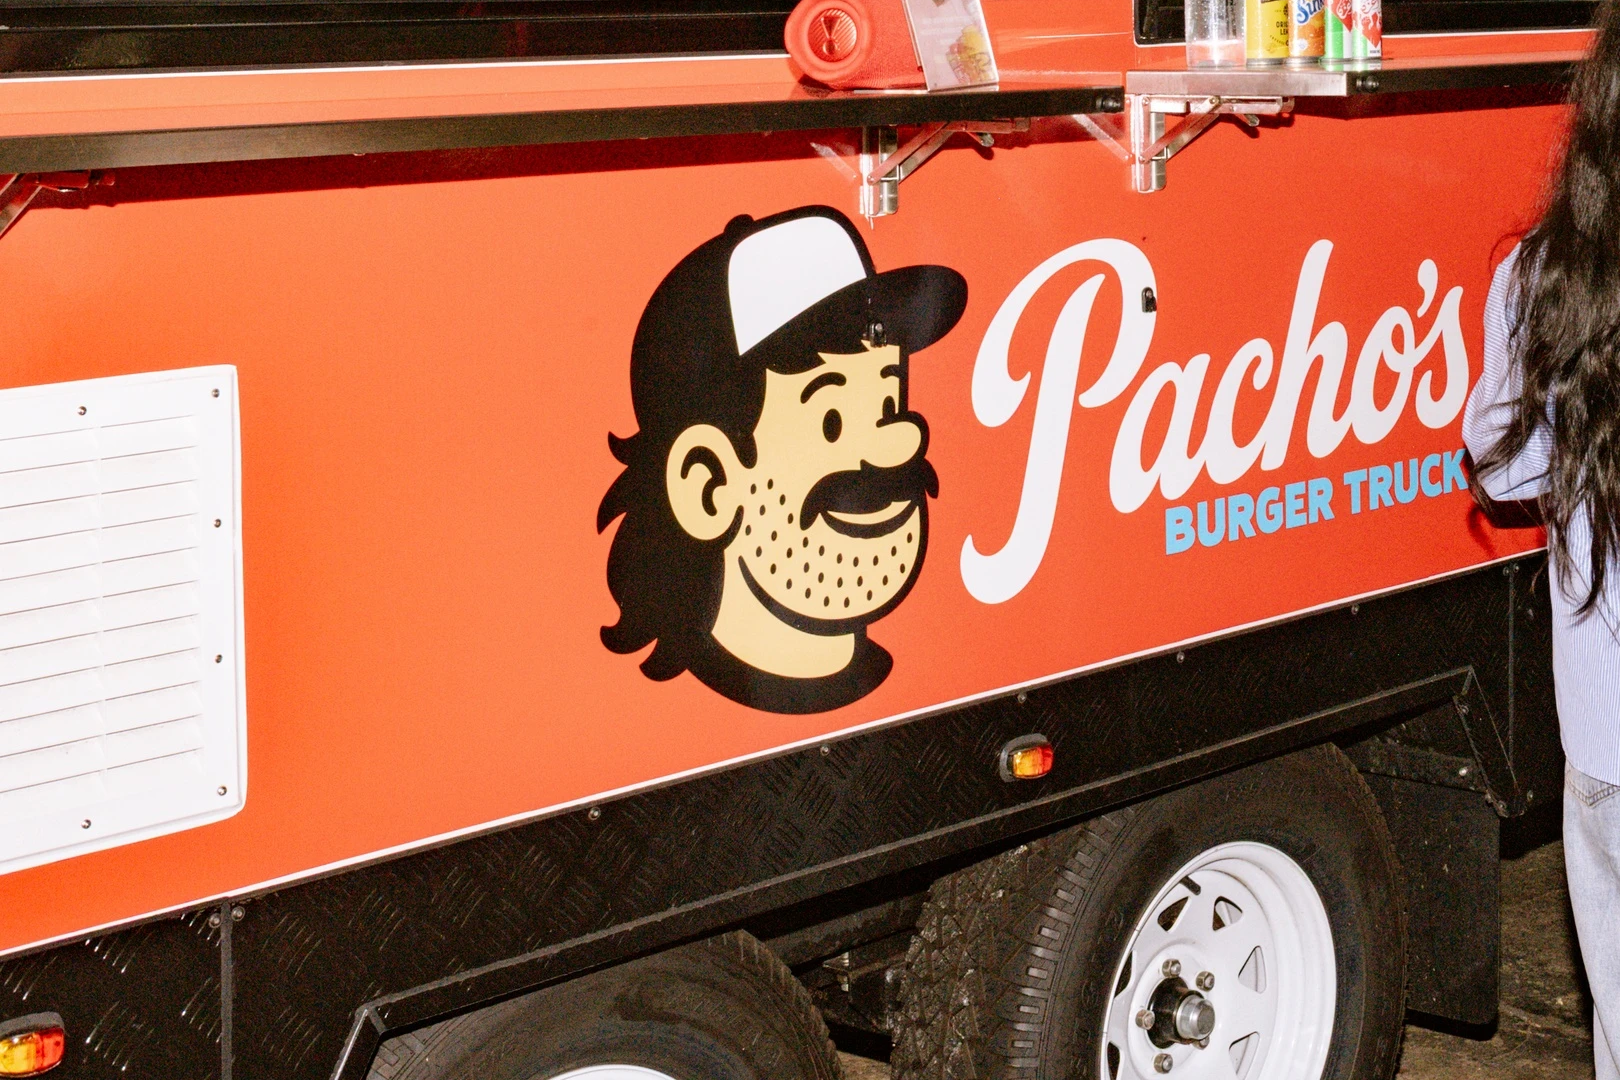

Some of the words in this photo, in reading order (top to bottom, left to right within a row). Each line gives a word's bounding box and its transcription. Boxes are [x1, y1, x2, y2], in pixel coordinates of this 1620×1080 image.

[960, 237, 1469, 604] Pacho's
[1165, 476, 1334, 555] BURGER
[1344, 448, 1470, 514] TRUCK
